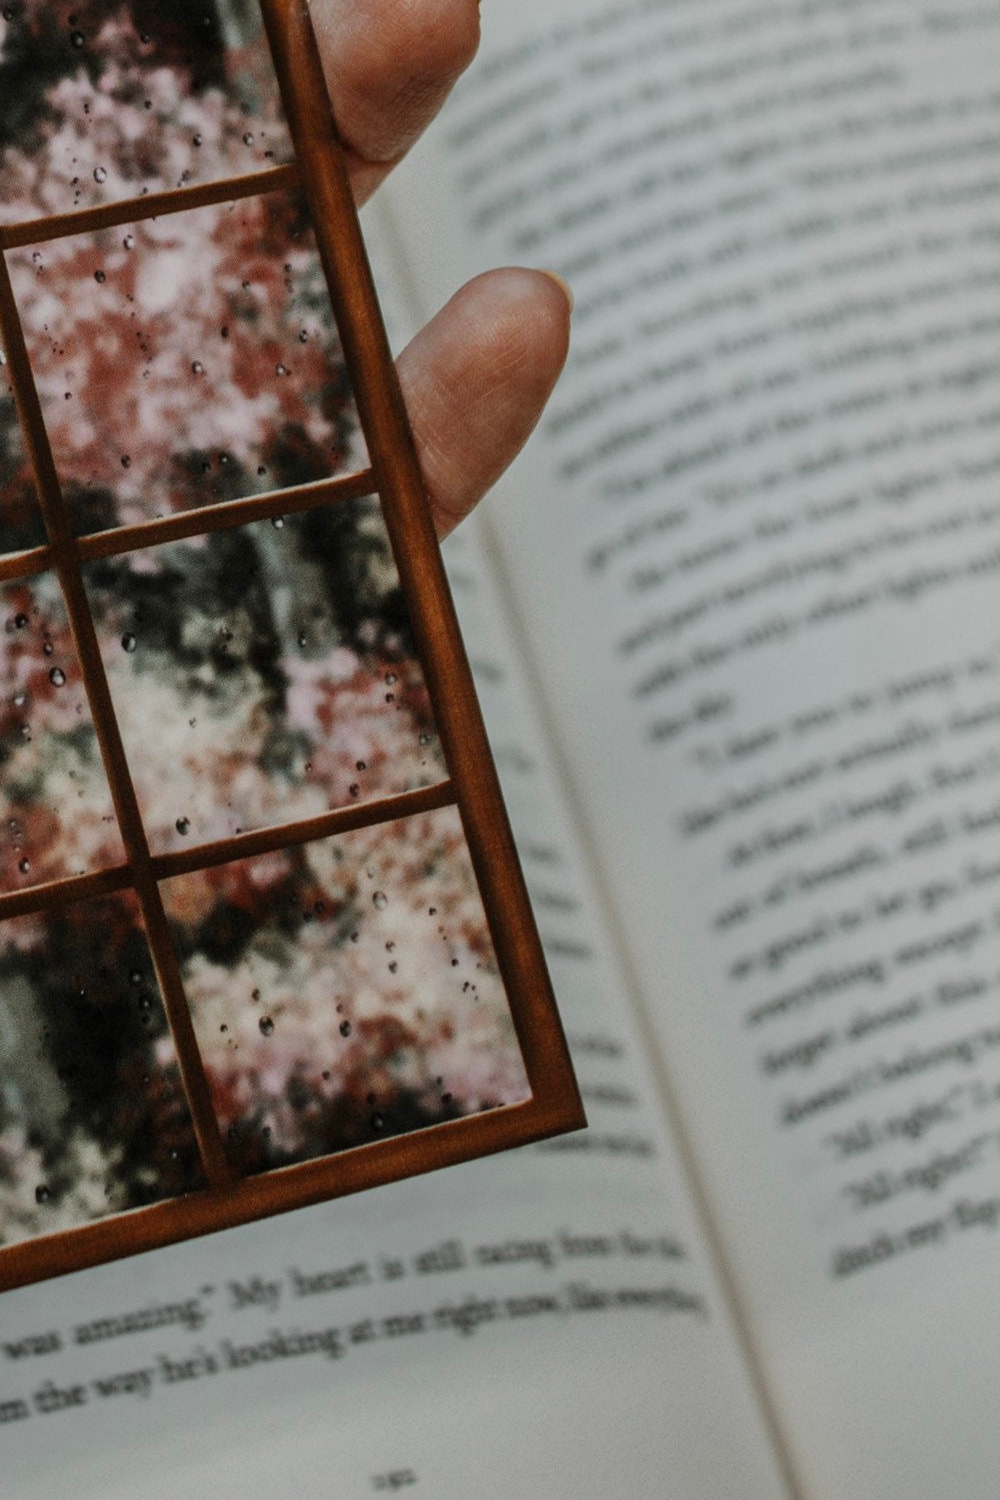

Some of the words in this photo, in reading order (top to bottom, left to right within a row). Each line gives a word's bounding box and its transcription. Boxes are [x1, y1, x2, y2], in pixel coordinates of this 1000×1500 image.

[3, 1332, 63, 1361] was
[230, 1275, 281, 1314] My
[286, 1263, 370, 1300] heart
[382, 1254, 404, 1281] is
[414, 1238, 463, 1276] still
[33, 1379, 89, 1414] the
[94, 1367, 153, 1397] way
[220, 1328, 343, 1371] looking
[350, 1317, 376, 1346] at
[382, 1311, 426, 1339] me
[433, 1292, 497, 1338] right
